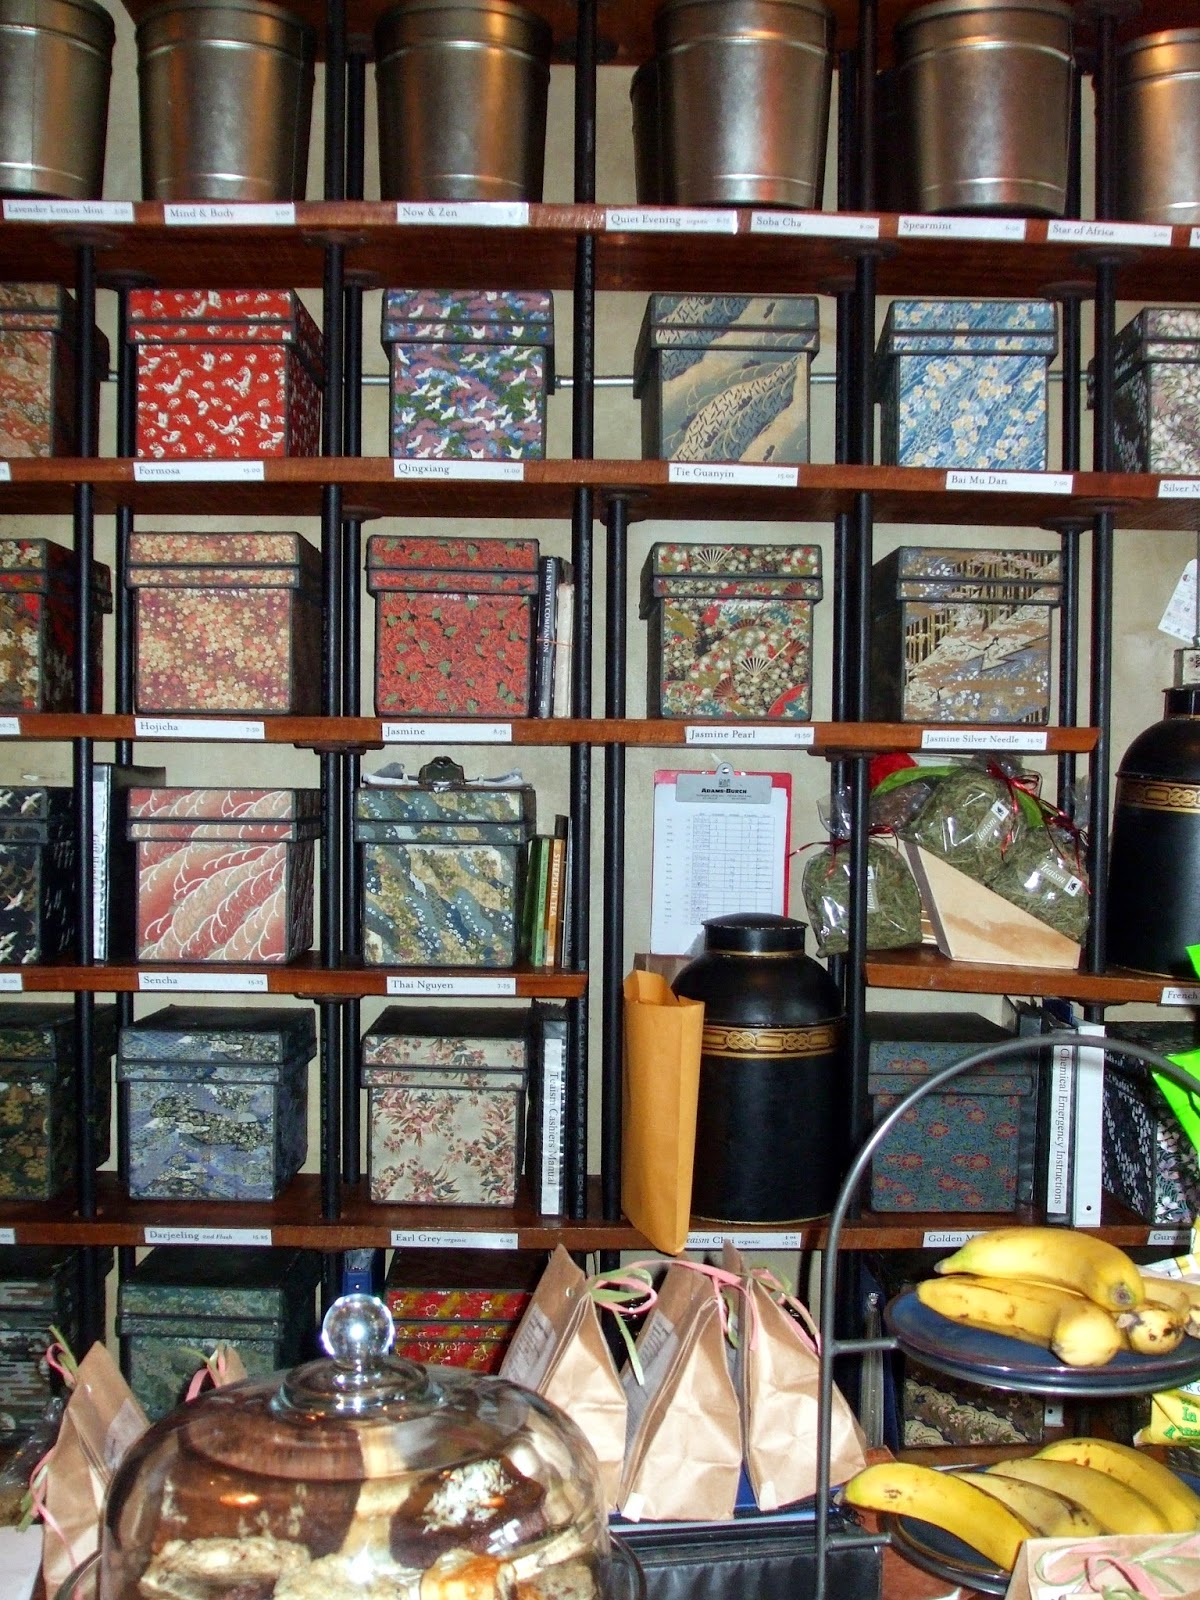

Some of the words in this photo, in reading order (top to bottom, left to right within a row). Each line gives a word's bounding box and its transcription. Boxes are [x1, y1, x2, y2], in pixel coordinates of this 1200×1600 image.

[8, 204, 46, 214] Lavender
[49, 205, 80, 214] Lemon
[83, 205, 104, 215] Mint
[169, 208, 196, 218] Mind
[199, 209, 207, 217] &
[210, 208, 234, 219] Body
[402, 208, 426, 217] Now
[427, 208, 435, 217] &
[438, 208, 458, 217] Zen
[610, 214, 639, 225] Quiet
[641, 214, 681, 226] Evening
[756, 216, 779, 227] Soba
[782, 217, 802, 228] Cha
[903, 220, 952, 231] Spearmint
[1052, 224, 1072, 235] Star
[1073, 225, 1084, 235] of
[1085, 226, 1114, 237] Africa
[138, 465, 181, 475] Formosa
[398, 463, 450, 475] Qingxiang
[674, 467, 690, 477] Tie
[693, 468, 735, 480] Guanyin
[951, 475, 966, 484] Bai
[969, 476, 985, 484] Mu
[988, 476, 1008, 485] Dan
[1162, 483, 1189, 493] Silver
[140, 721, 179, 733] Hojicha
[385, 727, 426, 737] Jasmine
[689, 730, 729, 740] Jasmine
[732, 730, 756, 739] Pearl
[925, 734, 960, 745] Jasmine
[962, 734, 987, 743] Silver
[989, 735, 1019, 744] Needle
[977, 816, 998, 842] Teaism
[552, 853, 561, 888] STEEPED
[1040, 861, 1067, 884] Teaism
[551, 889, 558, 899] IN
[550, 901, 558, 917] TEA
[143, 975, 178, 985] Sencha
[391, 980, 414, 989] Thai
[417, 980, 454, 991] Nguyen
[1167, 991, 1198, 1000] French
[1059, 1048, 1070, 1093] Chemical
[549, 1072, 559, 1105] Teaism
[1055, 1095, 1068, 1148] Emergency
[548, 1108, 559, 1148] Cashiers
[547, 1151, 558, 1185] Manual
[1054, 1151, 1066, 1205] Instructions
[149, 1231, 199, 1241] Darjeeling
[395, 1234, 415, 1242] Earl
[418, 1234, 442, 1244] Grey
[685, 1236, 710, 1244] eaism
[712, 1236, 735, 1244] Chi
[928, 1235, 963, 1243] Golden
